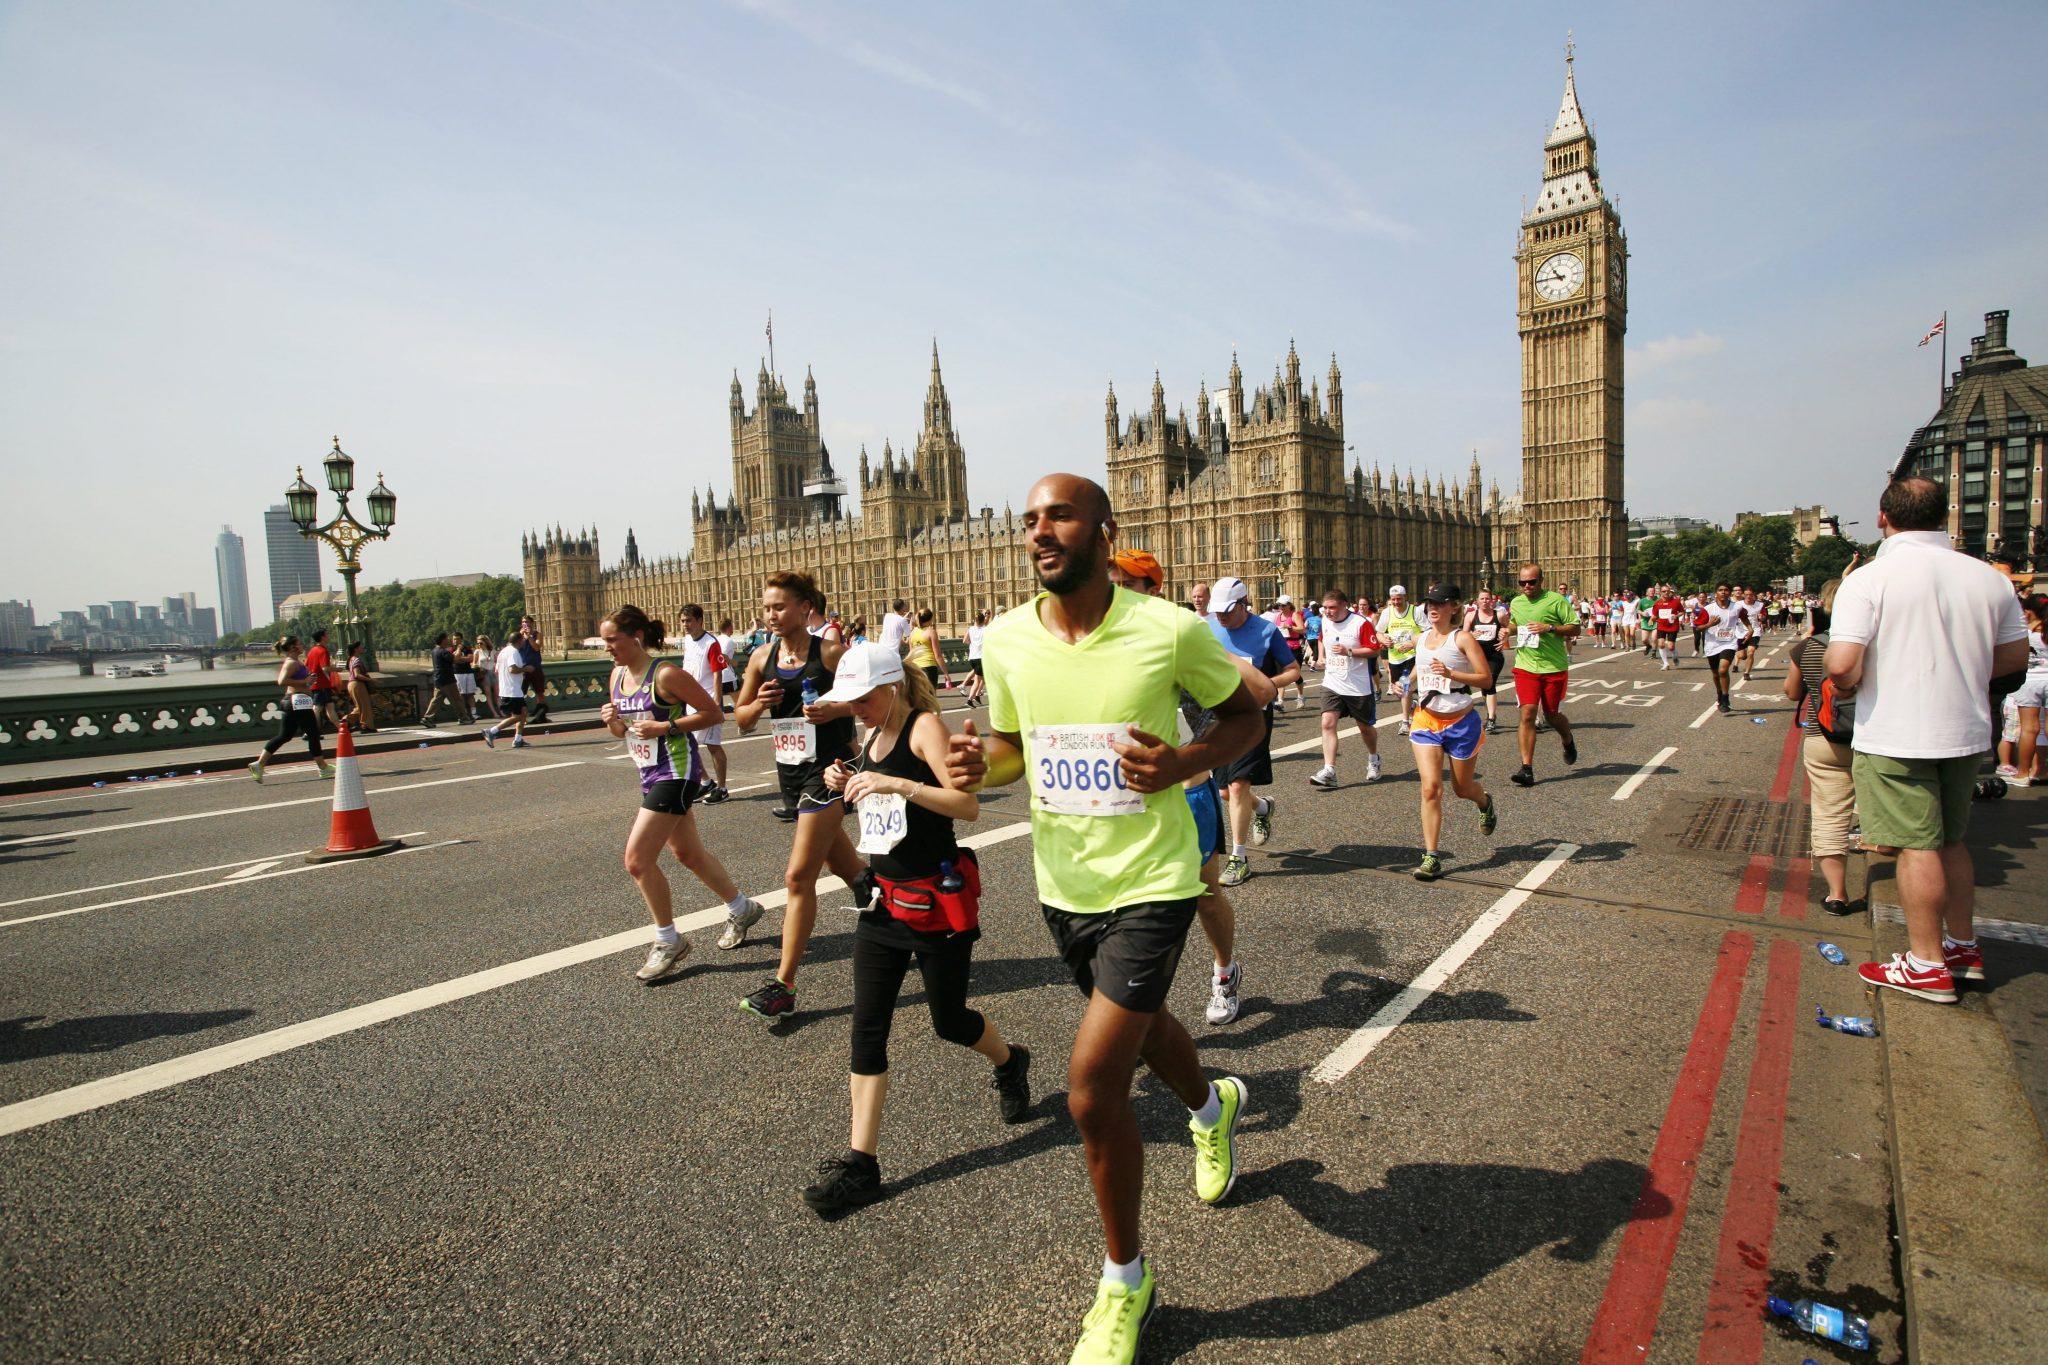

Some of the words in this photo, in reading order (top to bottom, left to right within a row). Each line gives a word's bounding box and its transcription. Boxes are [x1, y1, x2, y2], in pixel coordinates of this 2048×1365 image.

[1564, 692, 1665, 707] BU
[1060, 733, 1089, 742] BRITISH
[1060, 742, 1088, 750] LONDON
[1090, 742, 1106, 750] RUN
[1040, 757, 1128, 792] 30860
